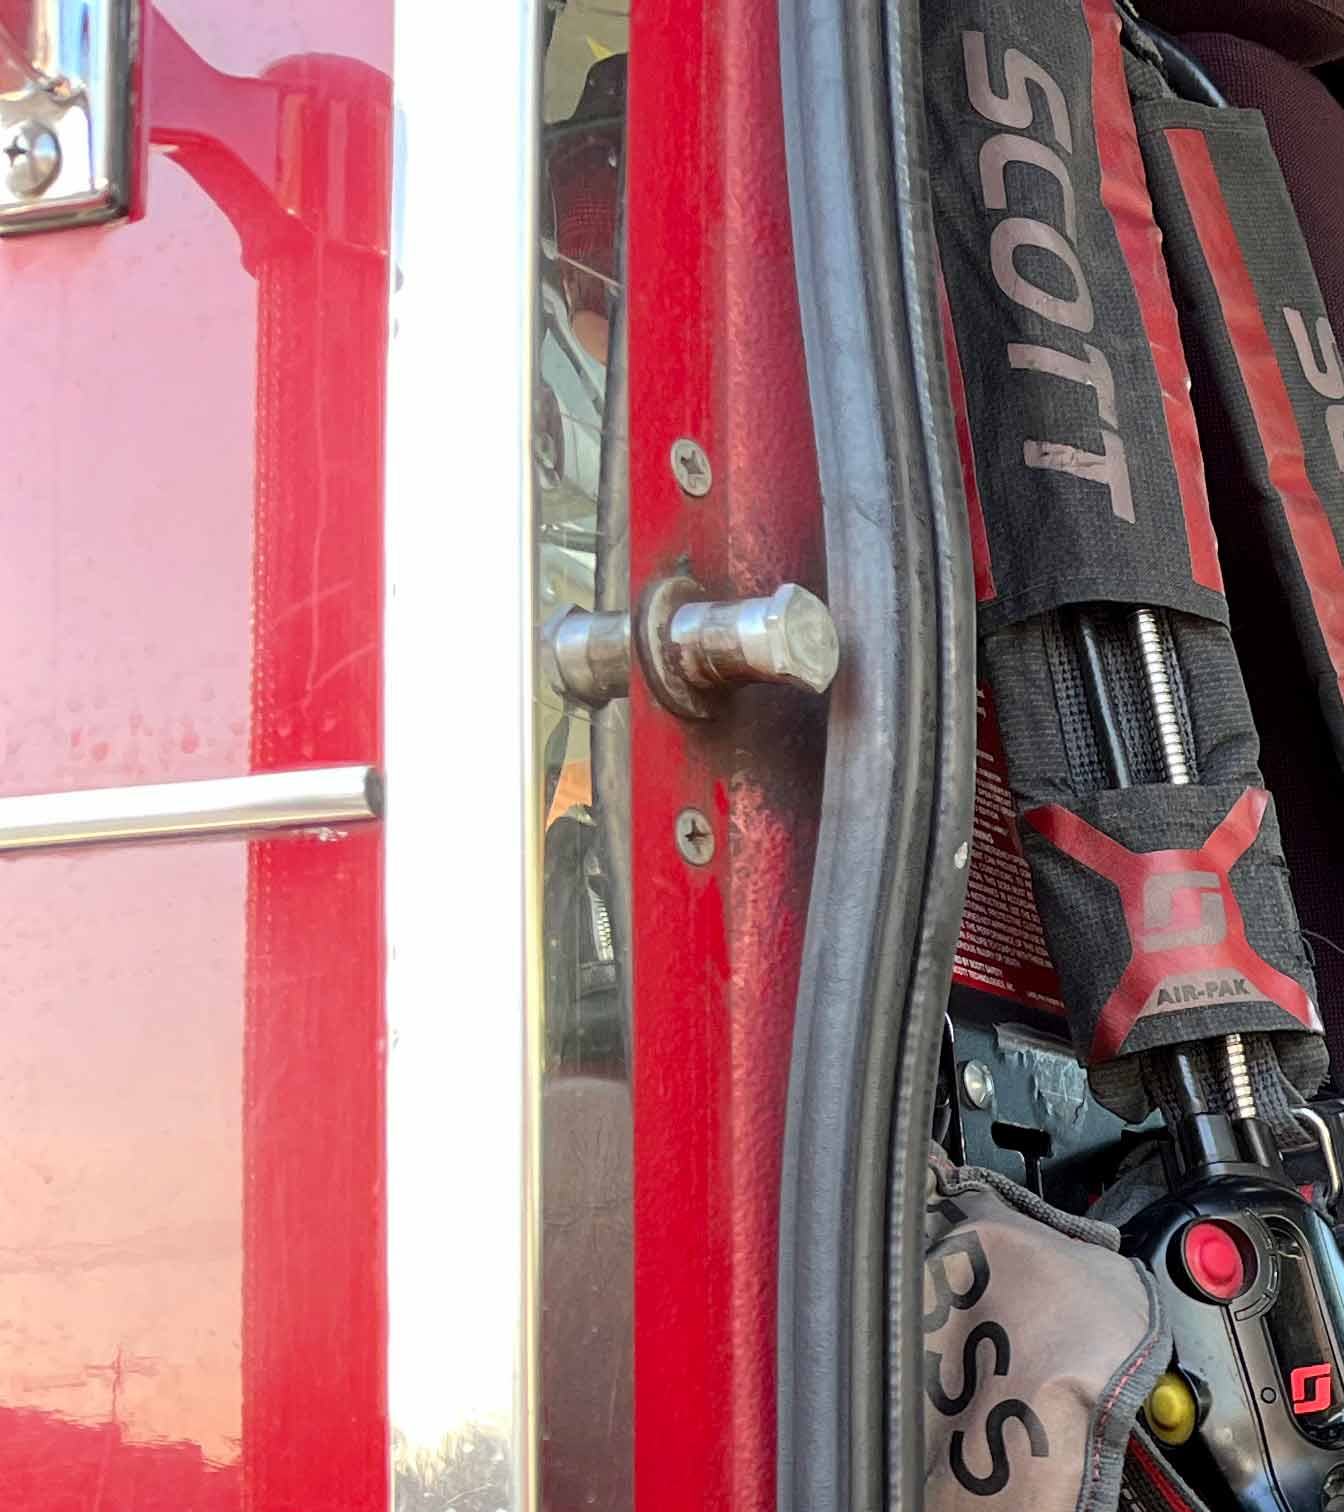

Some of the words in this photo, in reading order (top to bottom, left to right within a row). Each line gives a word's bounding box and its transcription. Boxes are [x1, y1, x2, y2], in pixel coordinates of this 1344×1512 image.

[962, 30, 1136, 524] SCOTT
[1157, 979, 1250, 1006] AIR-PAK
[926, 1203, 1049, 1496] BSS
